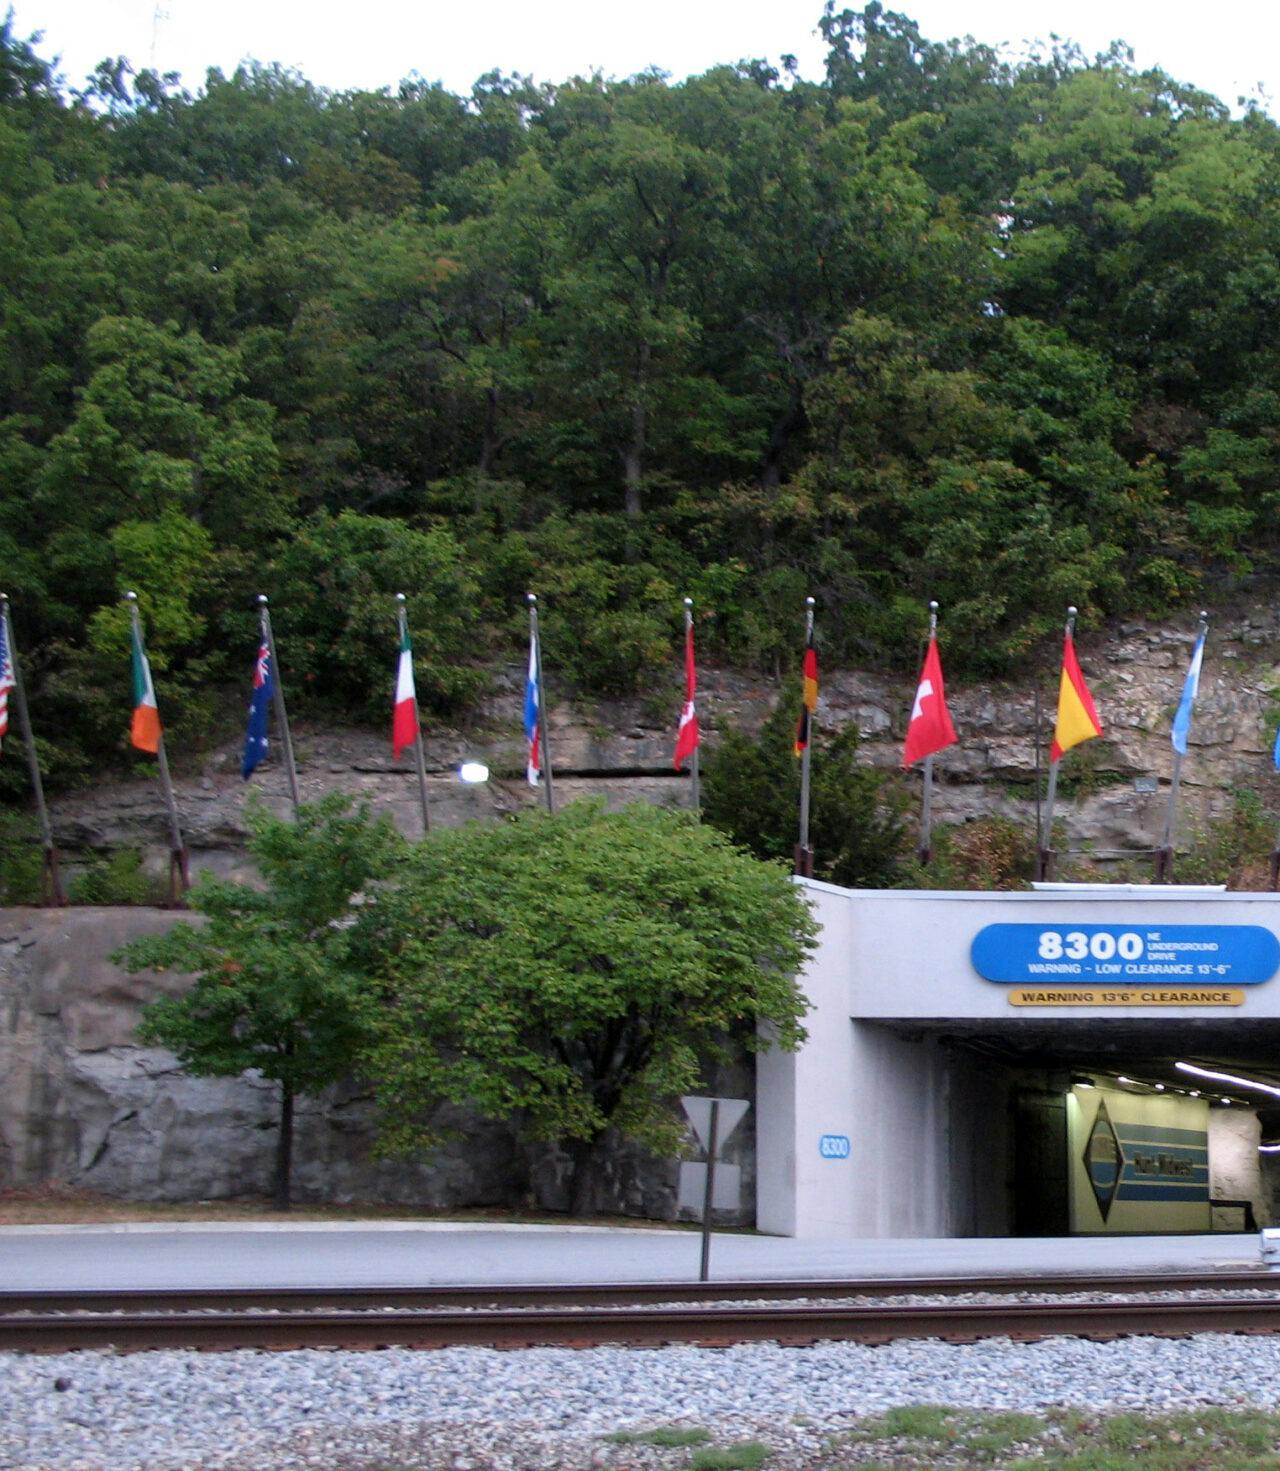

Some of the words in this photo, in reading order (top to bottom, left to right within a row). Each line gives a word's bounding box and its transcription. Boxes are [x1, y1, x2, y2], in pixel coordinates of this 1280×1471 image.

[1147, 933, 1161, 941] NE
[1038, 932, 1144, 960] 8300
[1147, 943, 1219, 951] UNDERGROUND
[1147, 953, 1176, 961] DRIVE
[1028, 964, 1081, 974] WARNING
[1096, 964, 1122, 974] LOW
[1125, 964, 1194, 974] CLEARANCE
[1022, 992, 1094, 1002] WARNING
[1141, 993, 1232, 1002] CLEARANCE
[822, 1137, 848, 1156] 8300
